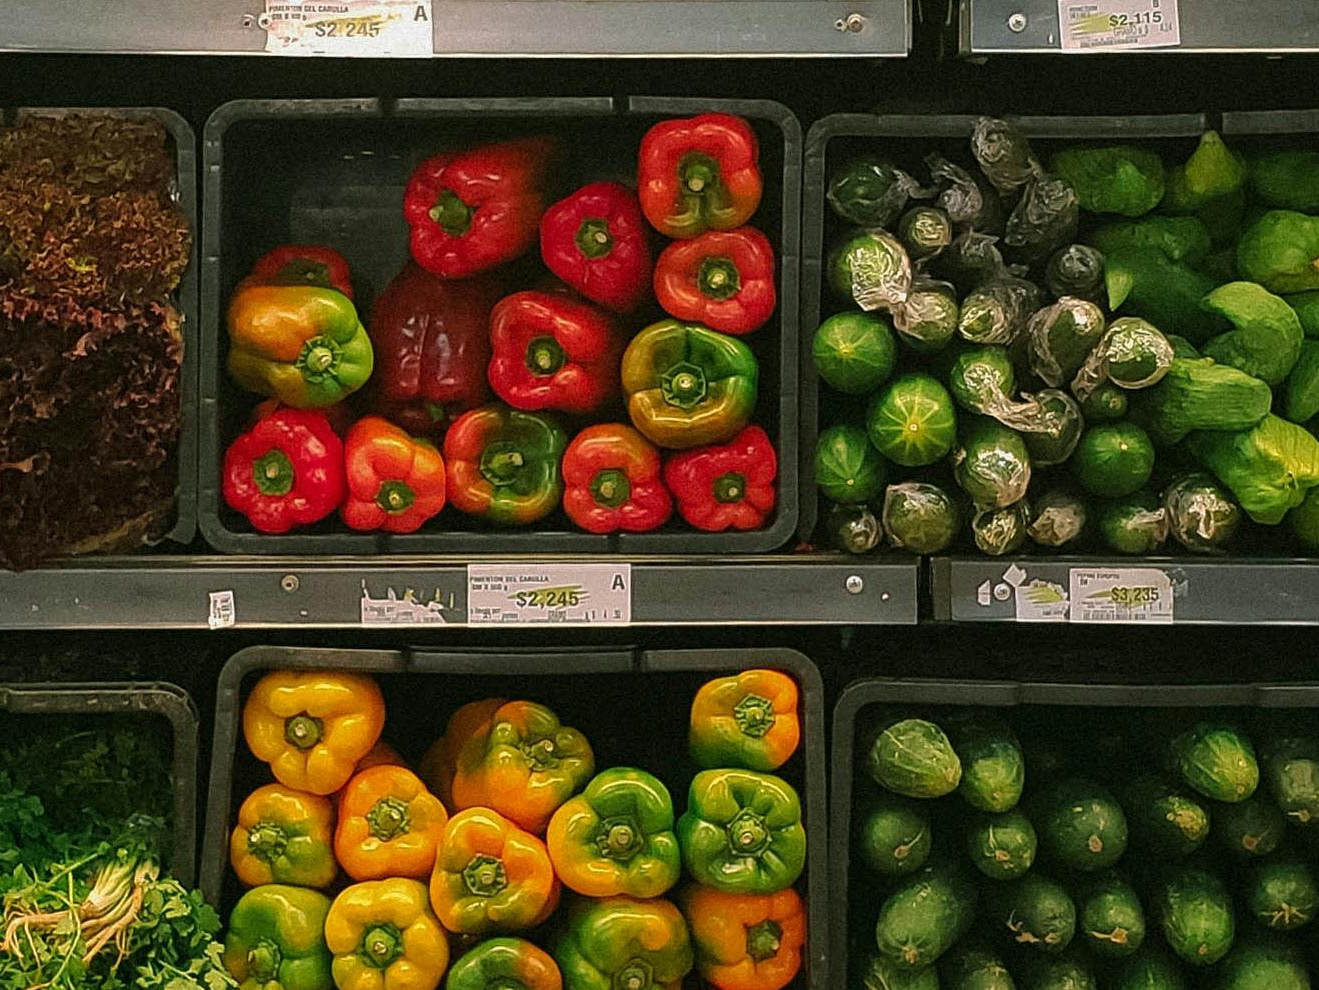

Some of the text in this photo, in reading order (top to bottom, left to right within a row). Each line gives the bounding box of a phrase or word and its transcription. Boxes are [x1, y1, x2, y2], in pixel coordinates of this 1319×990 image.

[414, 6, 428, 21] A
[1109, 11, 1162, 27] $2,115
[612, 575, 625, 590] A
[516, 592, 579, 609] $2,245
[1112, 587, 1160, 603] $3,235
